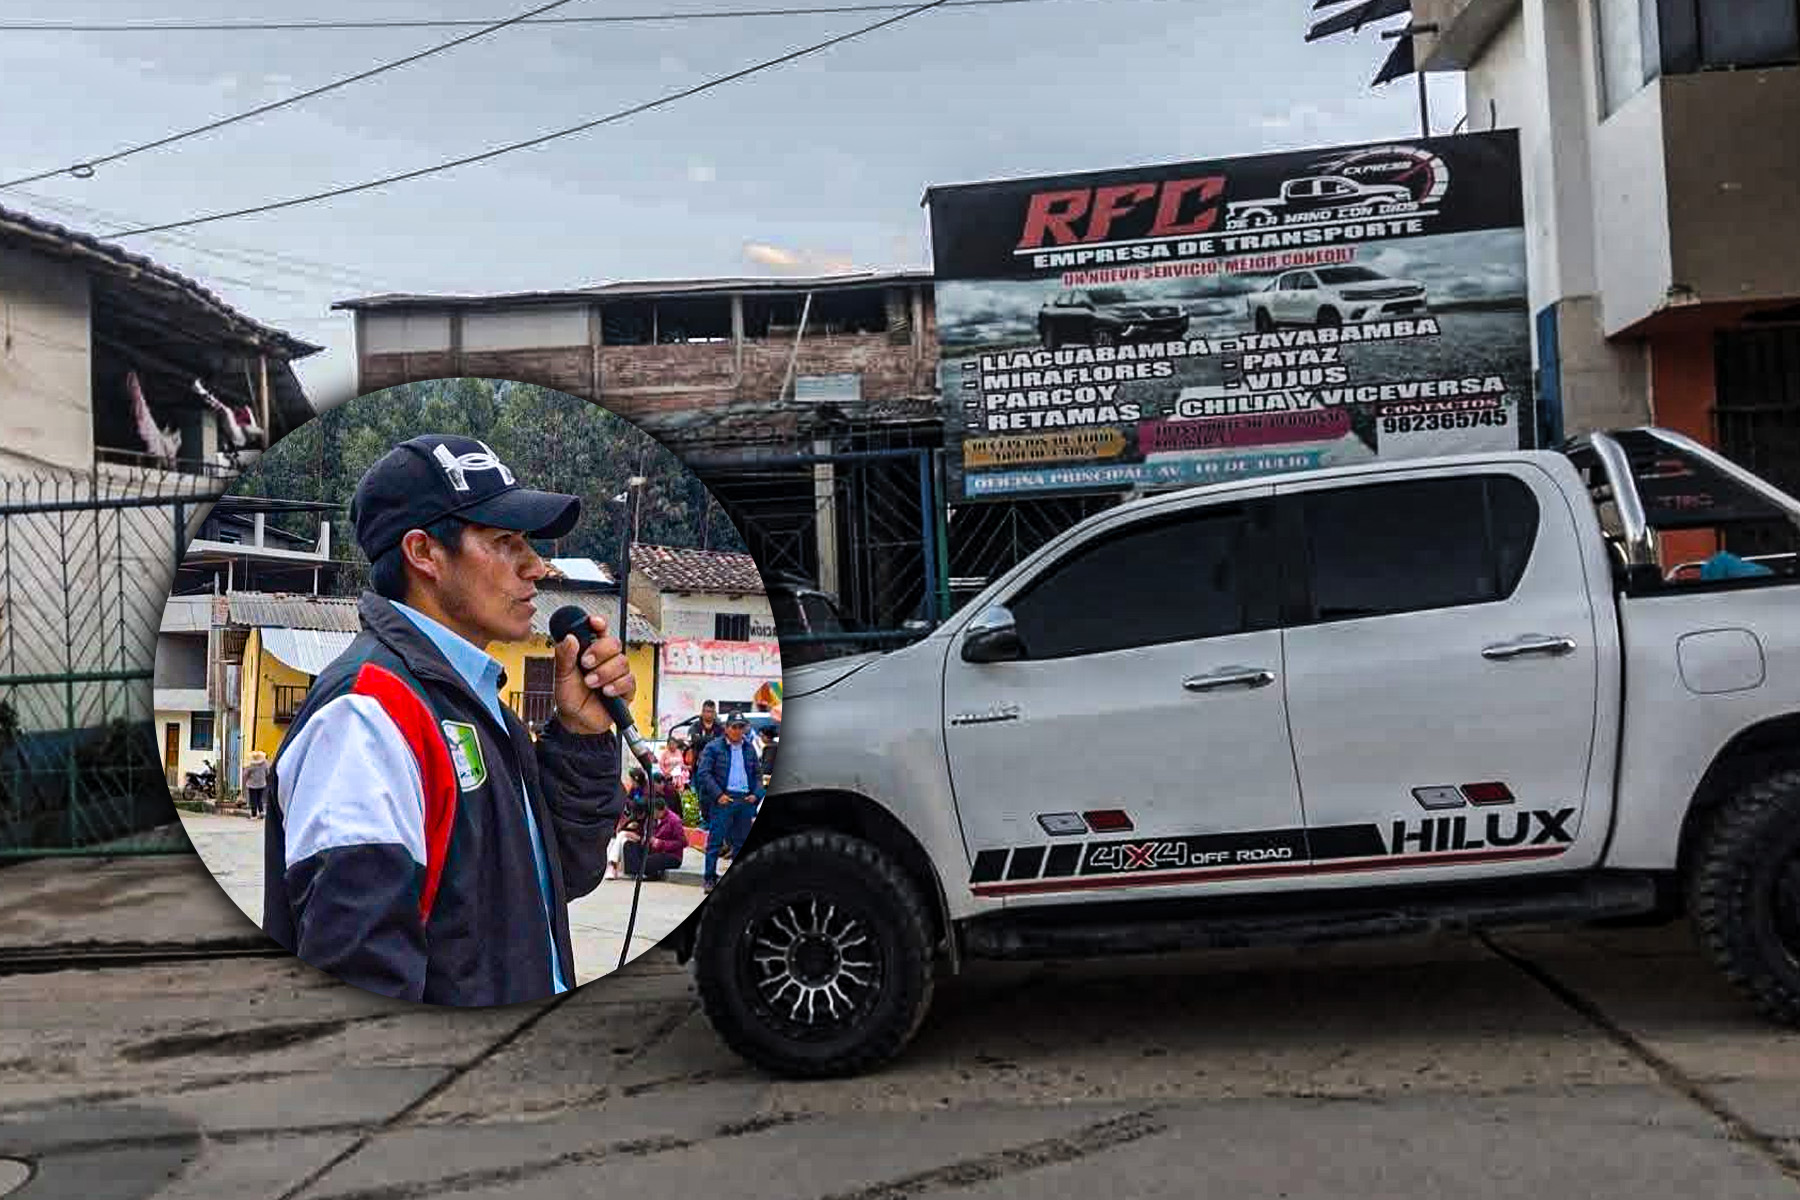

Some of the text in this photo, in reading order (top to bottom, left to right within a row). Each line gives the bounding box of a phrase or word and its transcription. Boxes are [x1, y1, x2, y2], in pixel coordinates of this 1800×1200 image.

[1016, 176, 1226, 248] RFC
[1255, 215, 1278, 227] LA
[1033, 219, 1424, 269] EMPRESA DE TRANSPORTE
[1087, 267, 1140, 285] NUEVO
[1225, 253, 1278, 273] MEJOR
[1241, 317, 1441, 351] TAYABAMBA
[982, 338, 1210, 371] LLACUABAMBA
[1243, 347, 1340, 371] PATAZ
[983, 361, 1174, 391] MIRAFLORES
[1248, 365, 1348, 390] VIJUS
[986, 384, 1119, 411] PARCOY
[1294, 390, 1313, 408] Y
[1321, 376, 1505, 405] VICEVERSA
[1381, 398, 1499, 415] CONTACTOS
[988, 402, 1141, 431] RETAMAS
[1383, 409, 1508, 434] 982365745
[1391, 807, 1576, 855] HILUX
[1090, 841, 1293, 870] 4X4 OFF ROAD
